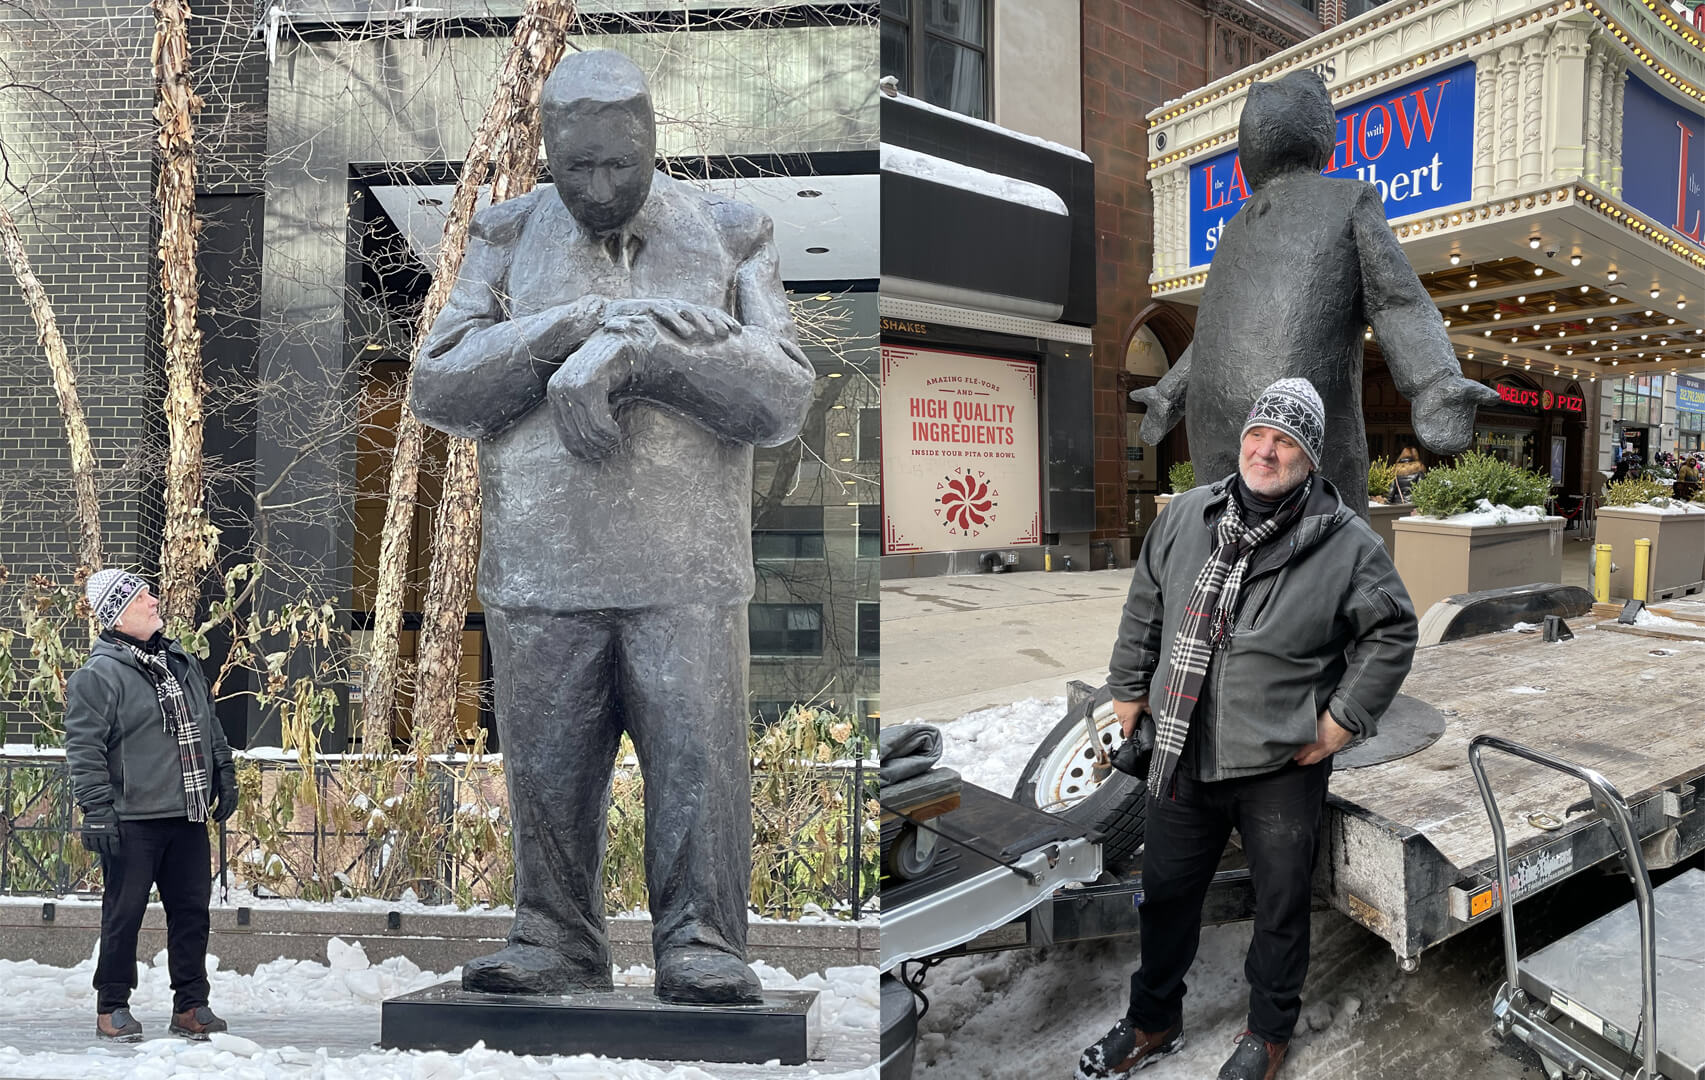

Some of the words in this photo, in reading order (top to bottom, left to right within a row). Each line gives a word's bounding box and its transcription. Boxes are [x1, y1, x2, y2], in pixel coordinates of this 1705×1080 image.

[1311, 57, 1337, 83] BS
[1367, 124, 1384, 138] with
[1203, 156, 1252, 211] LA
[1324, 79, 1451, 174] HOW
[1214, 179, 1224, 190] the
[926, 376, 963, 386] AMAZING
[910, 398, 947, 419] HIGH
[953, 400, 1015, 423] QUALITY
[1557, 395, 1583, 412] PIZZ
[912, 421, 1014, 445] INGREDIENTS
